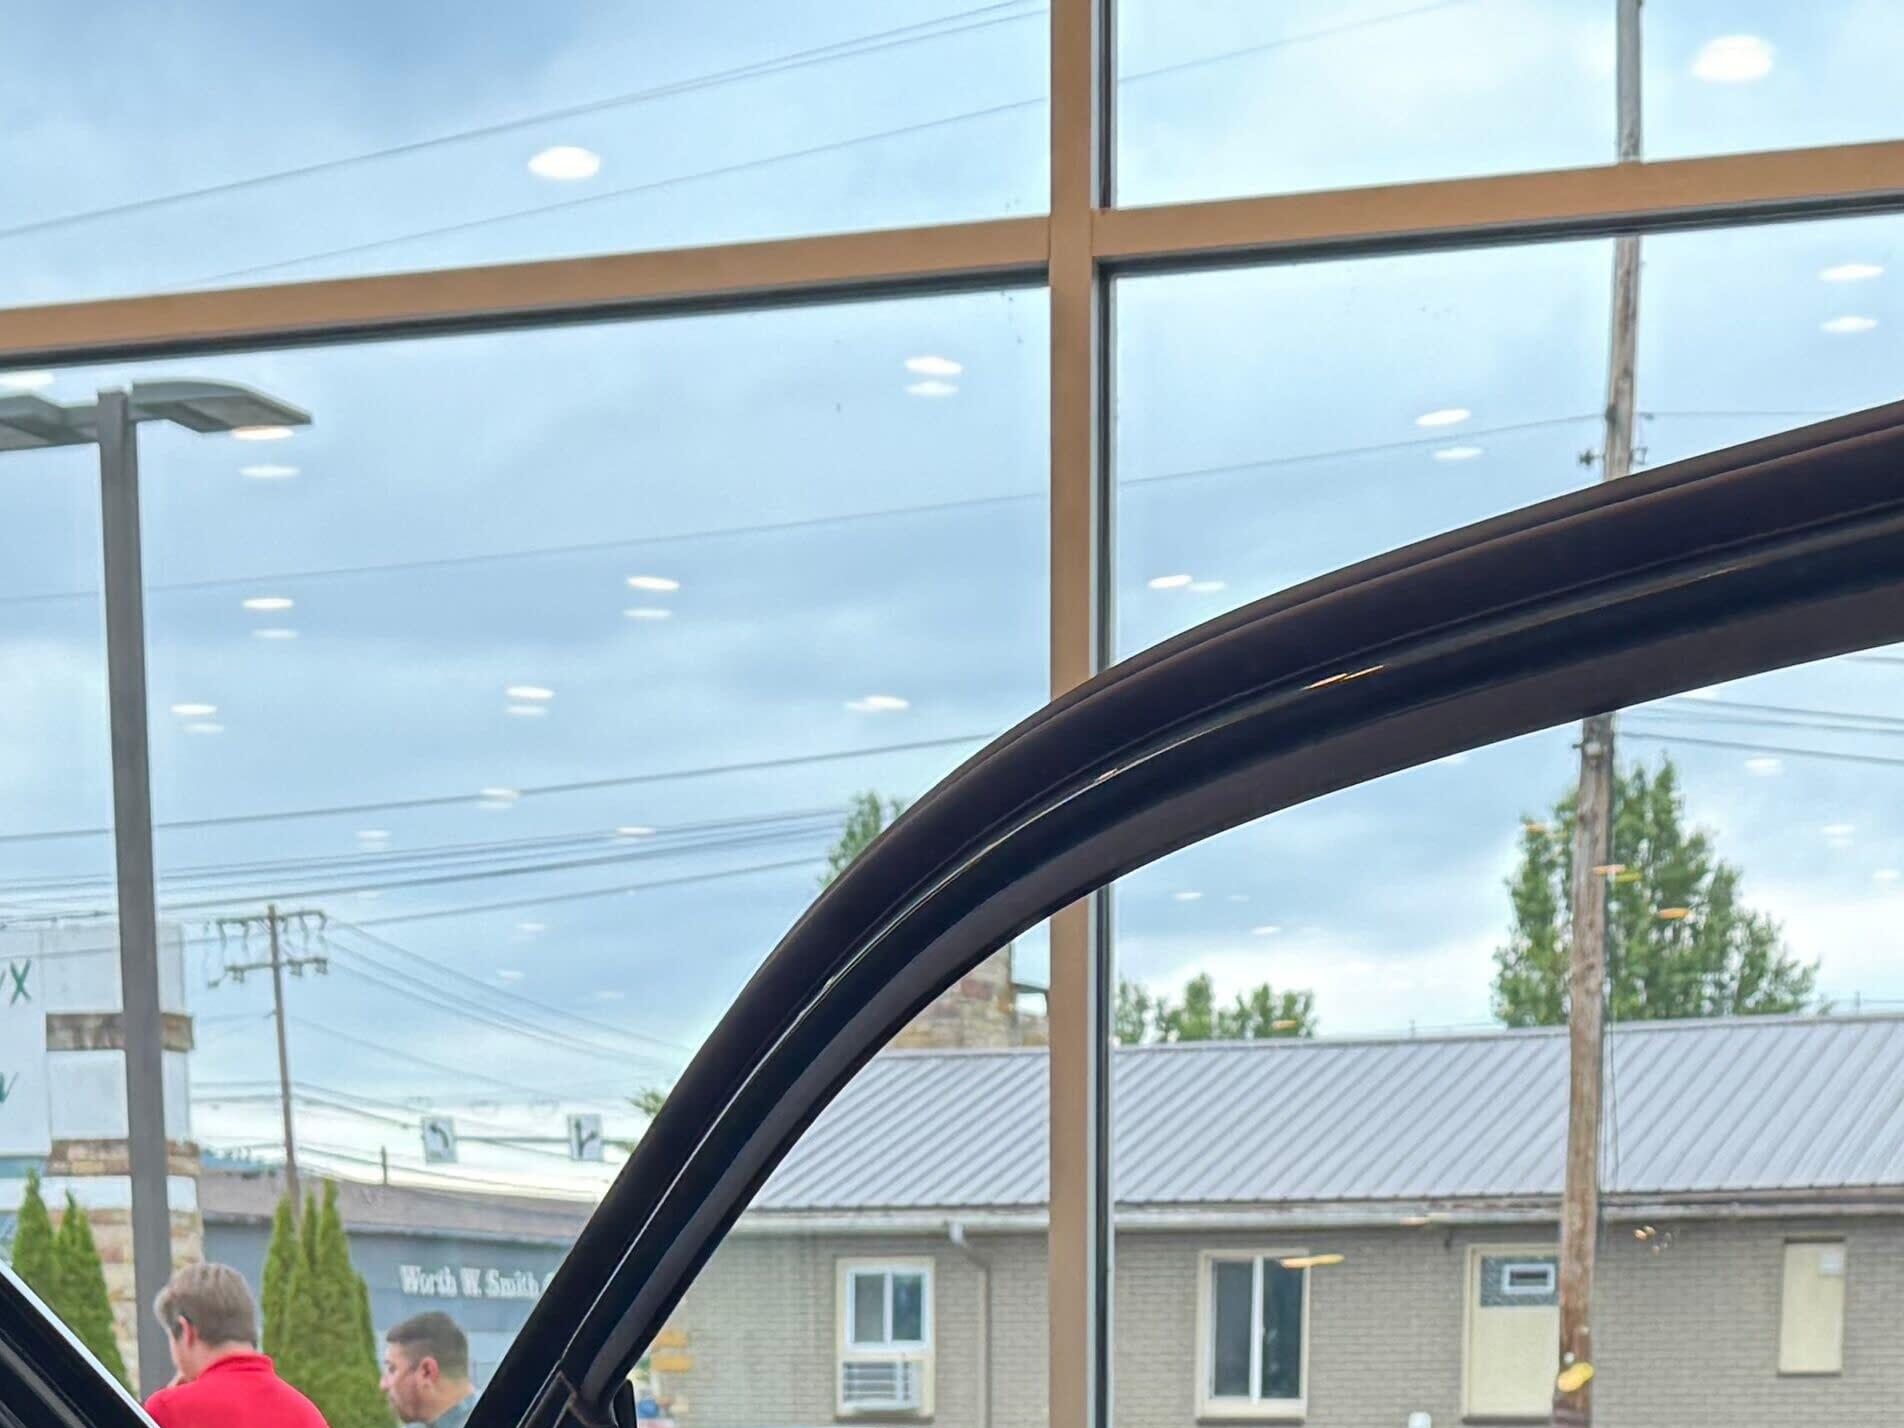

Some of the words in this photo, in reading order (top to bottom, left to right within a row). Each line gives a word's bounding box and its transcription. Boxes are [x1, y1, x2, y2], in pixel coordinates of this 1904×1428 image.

[399, 1264, 458, 1298] Worth
[459, 1266, 483, 1298] W.
[485, 1267, 541, 1300] Smith
